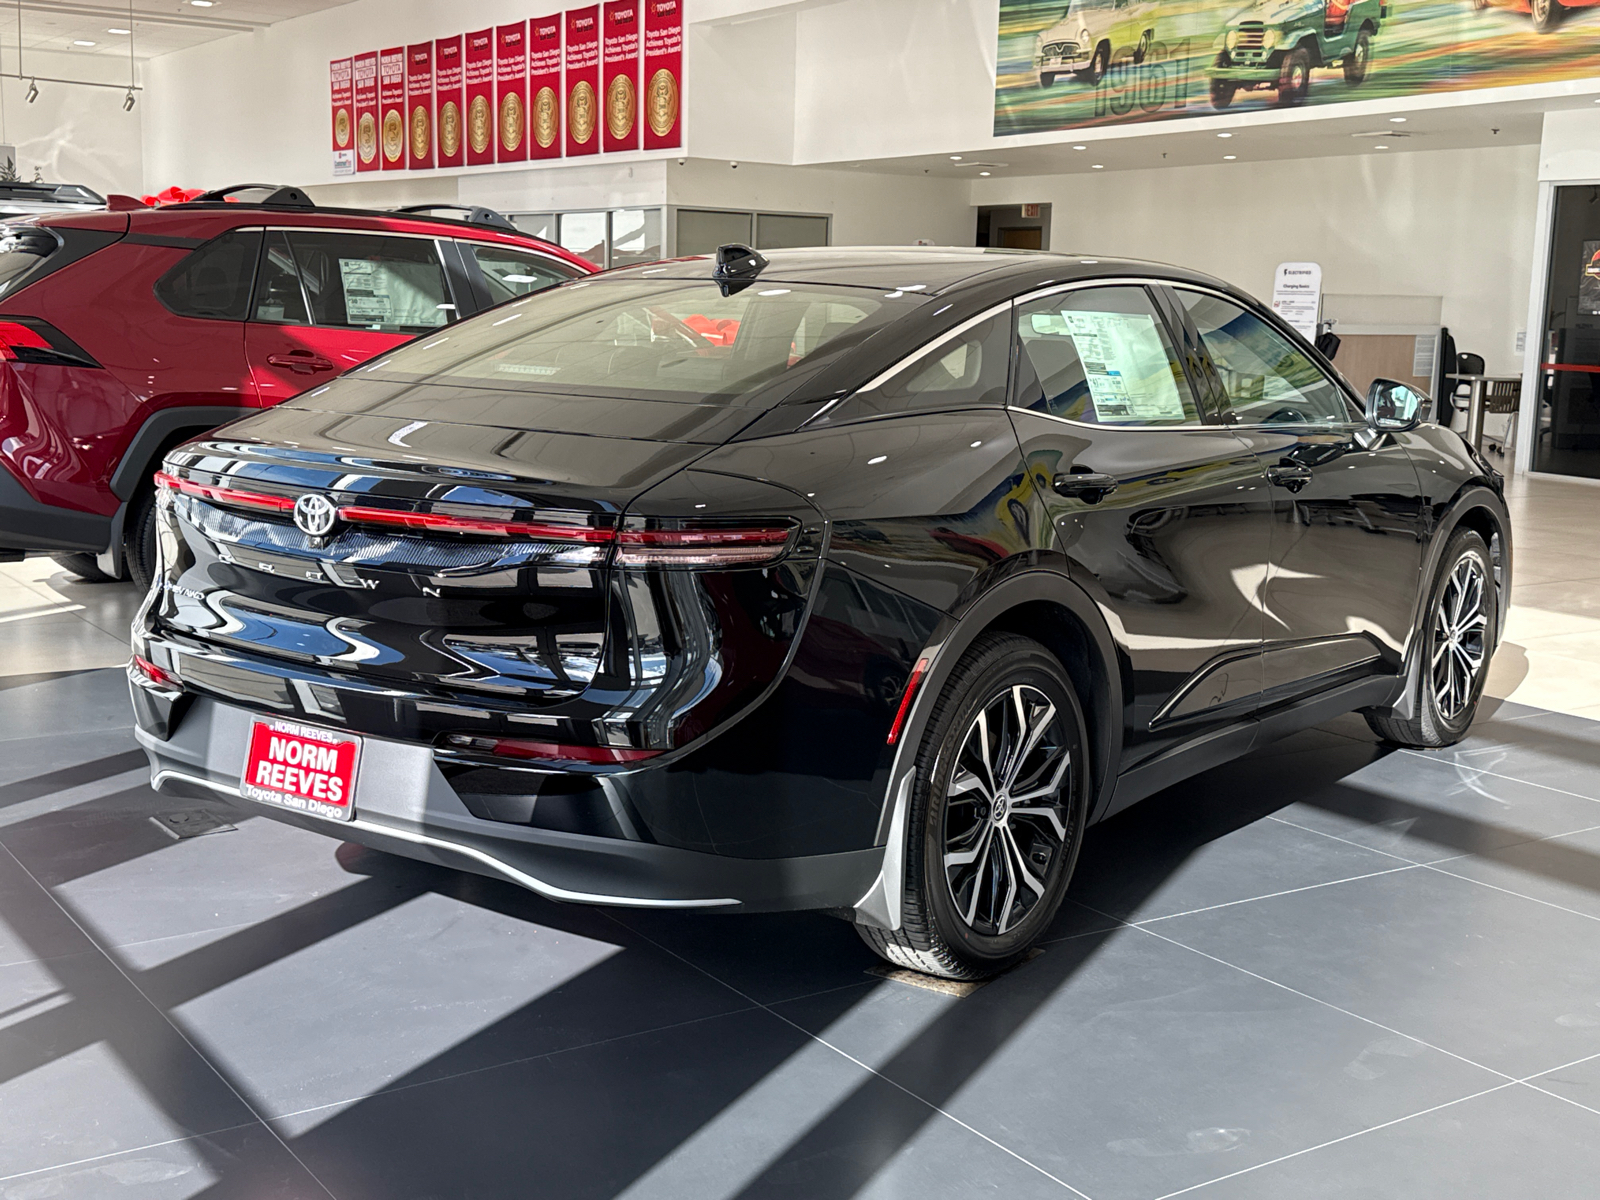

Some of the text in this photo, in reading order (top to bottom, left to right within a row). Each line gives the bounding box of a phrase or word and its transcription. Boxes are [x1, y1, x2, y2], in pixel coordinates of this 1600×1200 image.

[656, 1, 677, 12] TOYOTA
[614, 9, 634, 20] TOYOTA
[576, 17, 593, 28] TOYOTA
[540, 26, 556, 35] TOYOTA
[646, 25, 681, 39] Toyota San Diego
[505, 33, 521, 42] TOYOTA
[605, 37, 618, 45] Toyota
[626, 33, 638, 42] Diego
[646, 35, 681, 47] Achieves Toyota's
[567, 44, 578, 52] Toyota
[586, 41, 598, 49] Diego
[646, 43, 681, 57] President's Award
[625, 50, 638, 60] Award
[586, 57, 598, 66] Award
[1094, 37, 1191, 117] 1961
[274, 720, 334, 743] NORM REEVES
[268, 736, 338, 774] NORM
[255, 759, 344, 802] REEVES
[245, 784, 343, 818] Toyota San Diego
